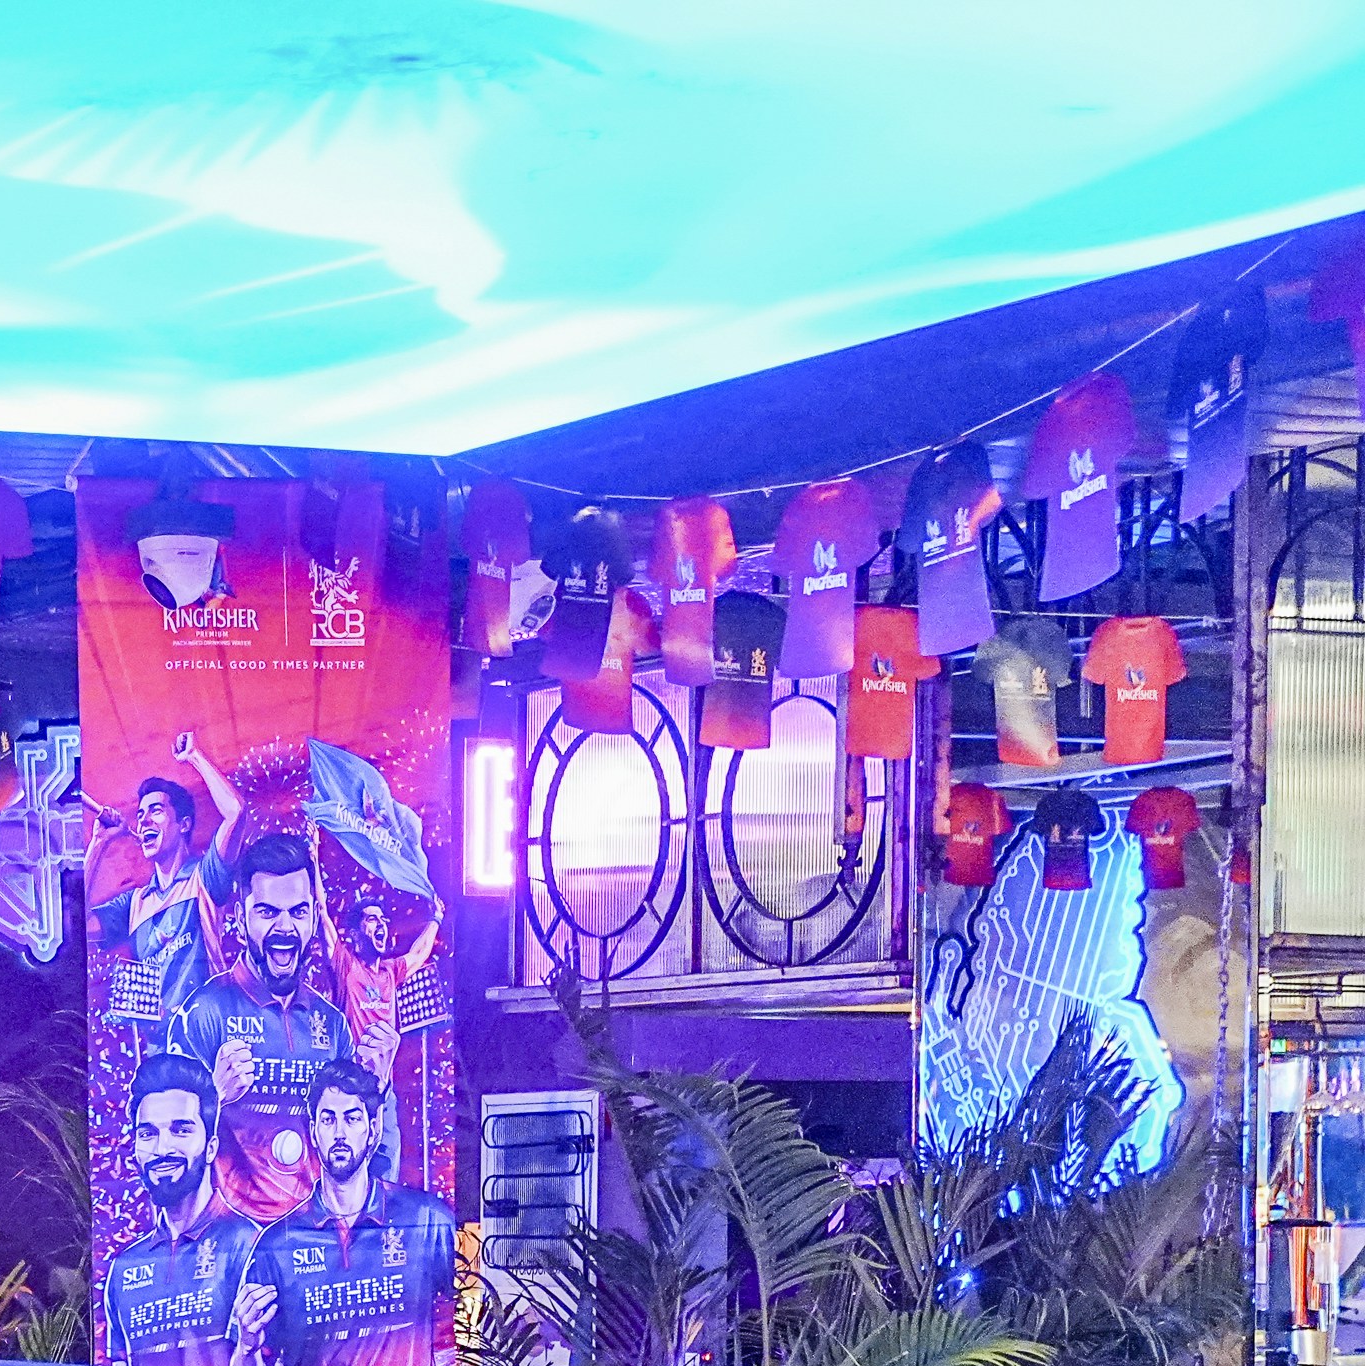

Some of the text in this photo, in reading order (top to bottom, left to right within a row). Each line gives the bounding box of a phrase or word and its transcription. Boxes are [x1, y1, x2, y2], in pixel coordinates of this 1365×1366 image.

[163, 607, 260, 634] KINGFISHER
[310, 608, 366, 638] RCB
[195, 630, 229, 638] PREMIUM
[164, 659, 365, 670] OFFICIAL GOOD TIMES PARTNER
[862, 677, 907, 695] KINGFISHER
[1117, 687, 1159, 702] KINGFISHER
[336, 802, 403, 856] KINGFISHER
[226, 1015, 265, 1035] SUN
[292, 1246, 326, 1266] SUN
[122, 1263, 155, 1285] SUN
[293, 1263, 327, 1276] PHARMA
[122, 1278, 154, 1293] PHARMA
[305, 1273, 404, 1312] NOTHING
[129, 1287, 214, 1329] NOTHING
[306, 1303, 406, 1326] SMARTPHONES
[129, 1315, 213, 1341] SMARTPHONES
